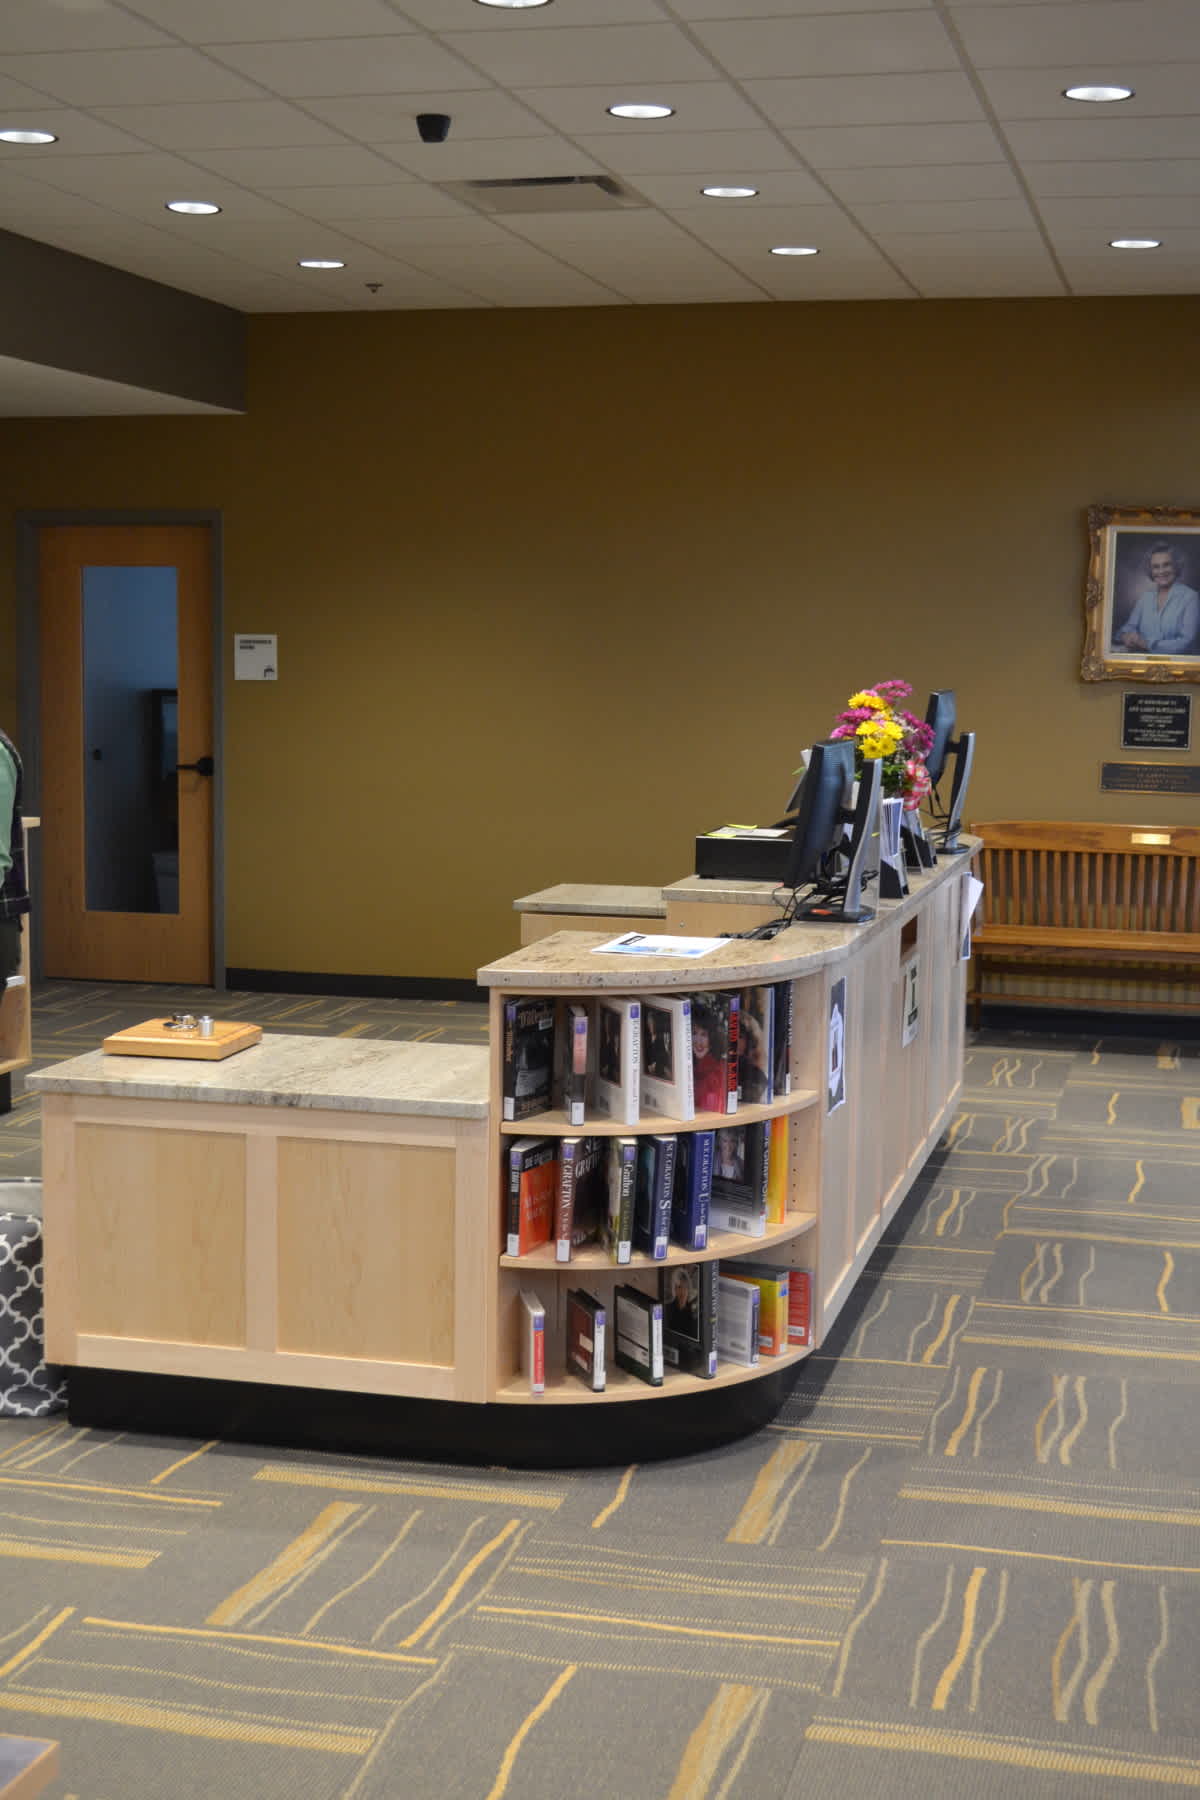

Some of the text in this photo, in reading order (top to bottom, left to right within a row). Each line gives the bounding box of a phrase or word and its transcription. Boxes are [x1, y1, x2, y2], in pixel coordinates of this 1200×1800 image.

[561, 1164, 574, 1208] GRAFTON
[622, 1164, 634, 1197] Grafton
[663, 1159, 673, 1199] GRAFTON
[659, 1199, 672, 1210] S
